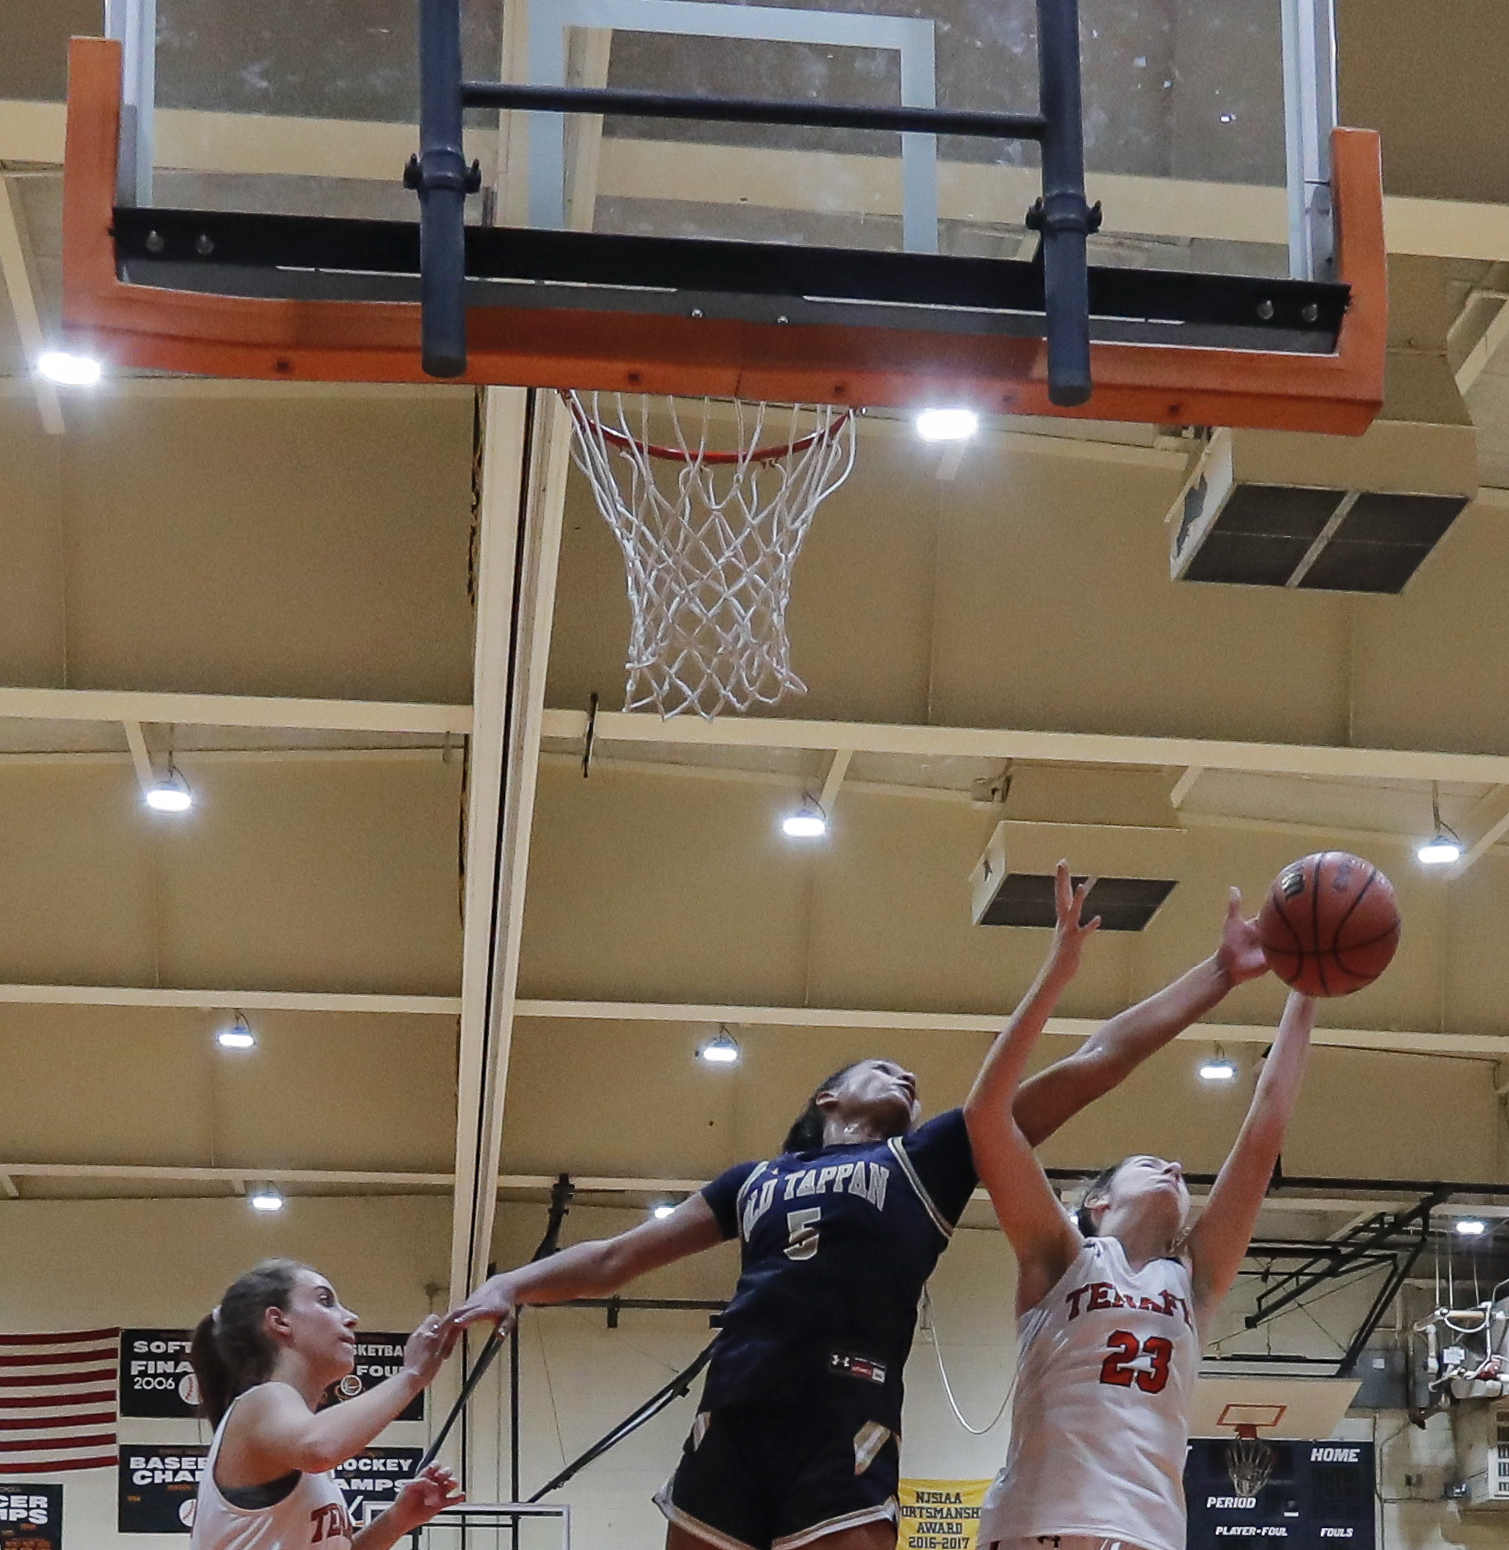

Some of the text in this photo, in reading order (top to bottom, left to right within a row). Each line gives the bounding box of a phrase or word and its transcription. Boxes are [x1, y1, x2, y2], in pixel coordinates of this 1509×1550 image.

[784, 1160, 890, 1212] TAPPAN
[783, 1206, 822, 1261] 5
[133, 1340, 193, 1354] SOFT
[352, 1344, 407, 1357] SKETBA
[131, 1361, 195, 1376] FINA
[1099, 1330, 1173, 1394] 23
[133, 1377, 175, 1390] 2006
[1310, 1448, 1360, 1463] HOME
[132, 1470, 204, 1486] CHA
[336, 1478, 409, 1493] AMPS
[915, 1491, 963, 1504] NJSIAA
[1207, 1496, 1256, 1509] PERIOD
[900, 1505, 983, 1519] ORTSMANSH
[916, 1522, 963, 1535] AWARD
[1320, 1527, 1353, 1538] FOULS
[908, 1536, 971, 1550] 2016-2017
